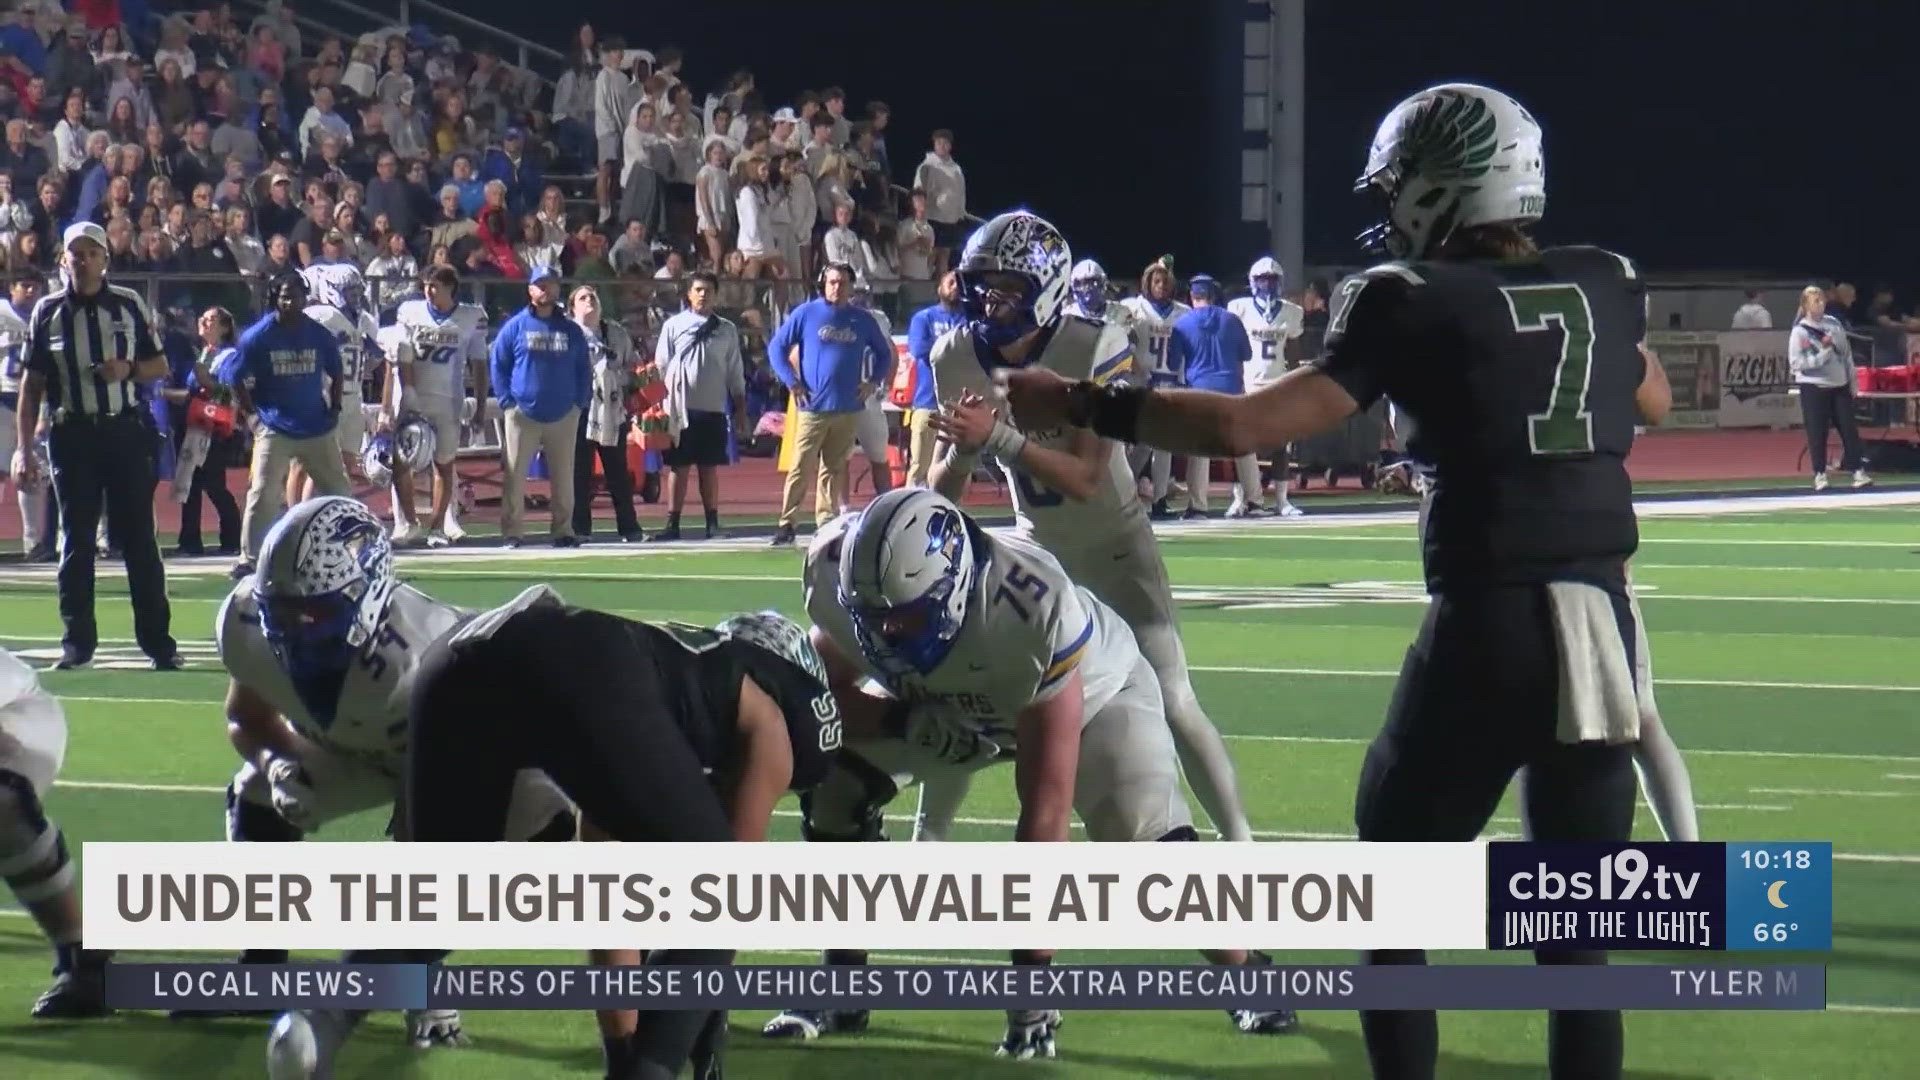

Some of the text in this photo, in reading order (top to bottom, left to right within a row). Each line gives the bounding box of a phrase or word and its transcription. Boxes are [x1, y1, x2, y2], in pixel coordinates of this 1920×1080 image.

[1331, 279, 1369, 334] 7
[1498, 284, 1596, 455] 7
[1724, 352, 1794, 386] LEGEN
[992, 562, 1050, 622] 75
[811, 690, 842, 752] 55
